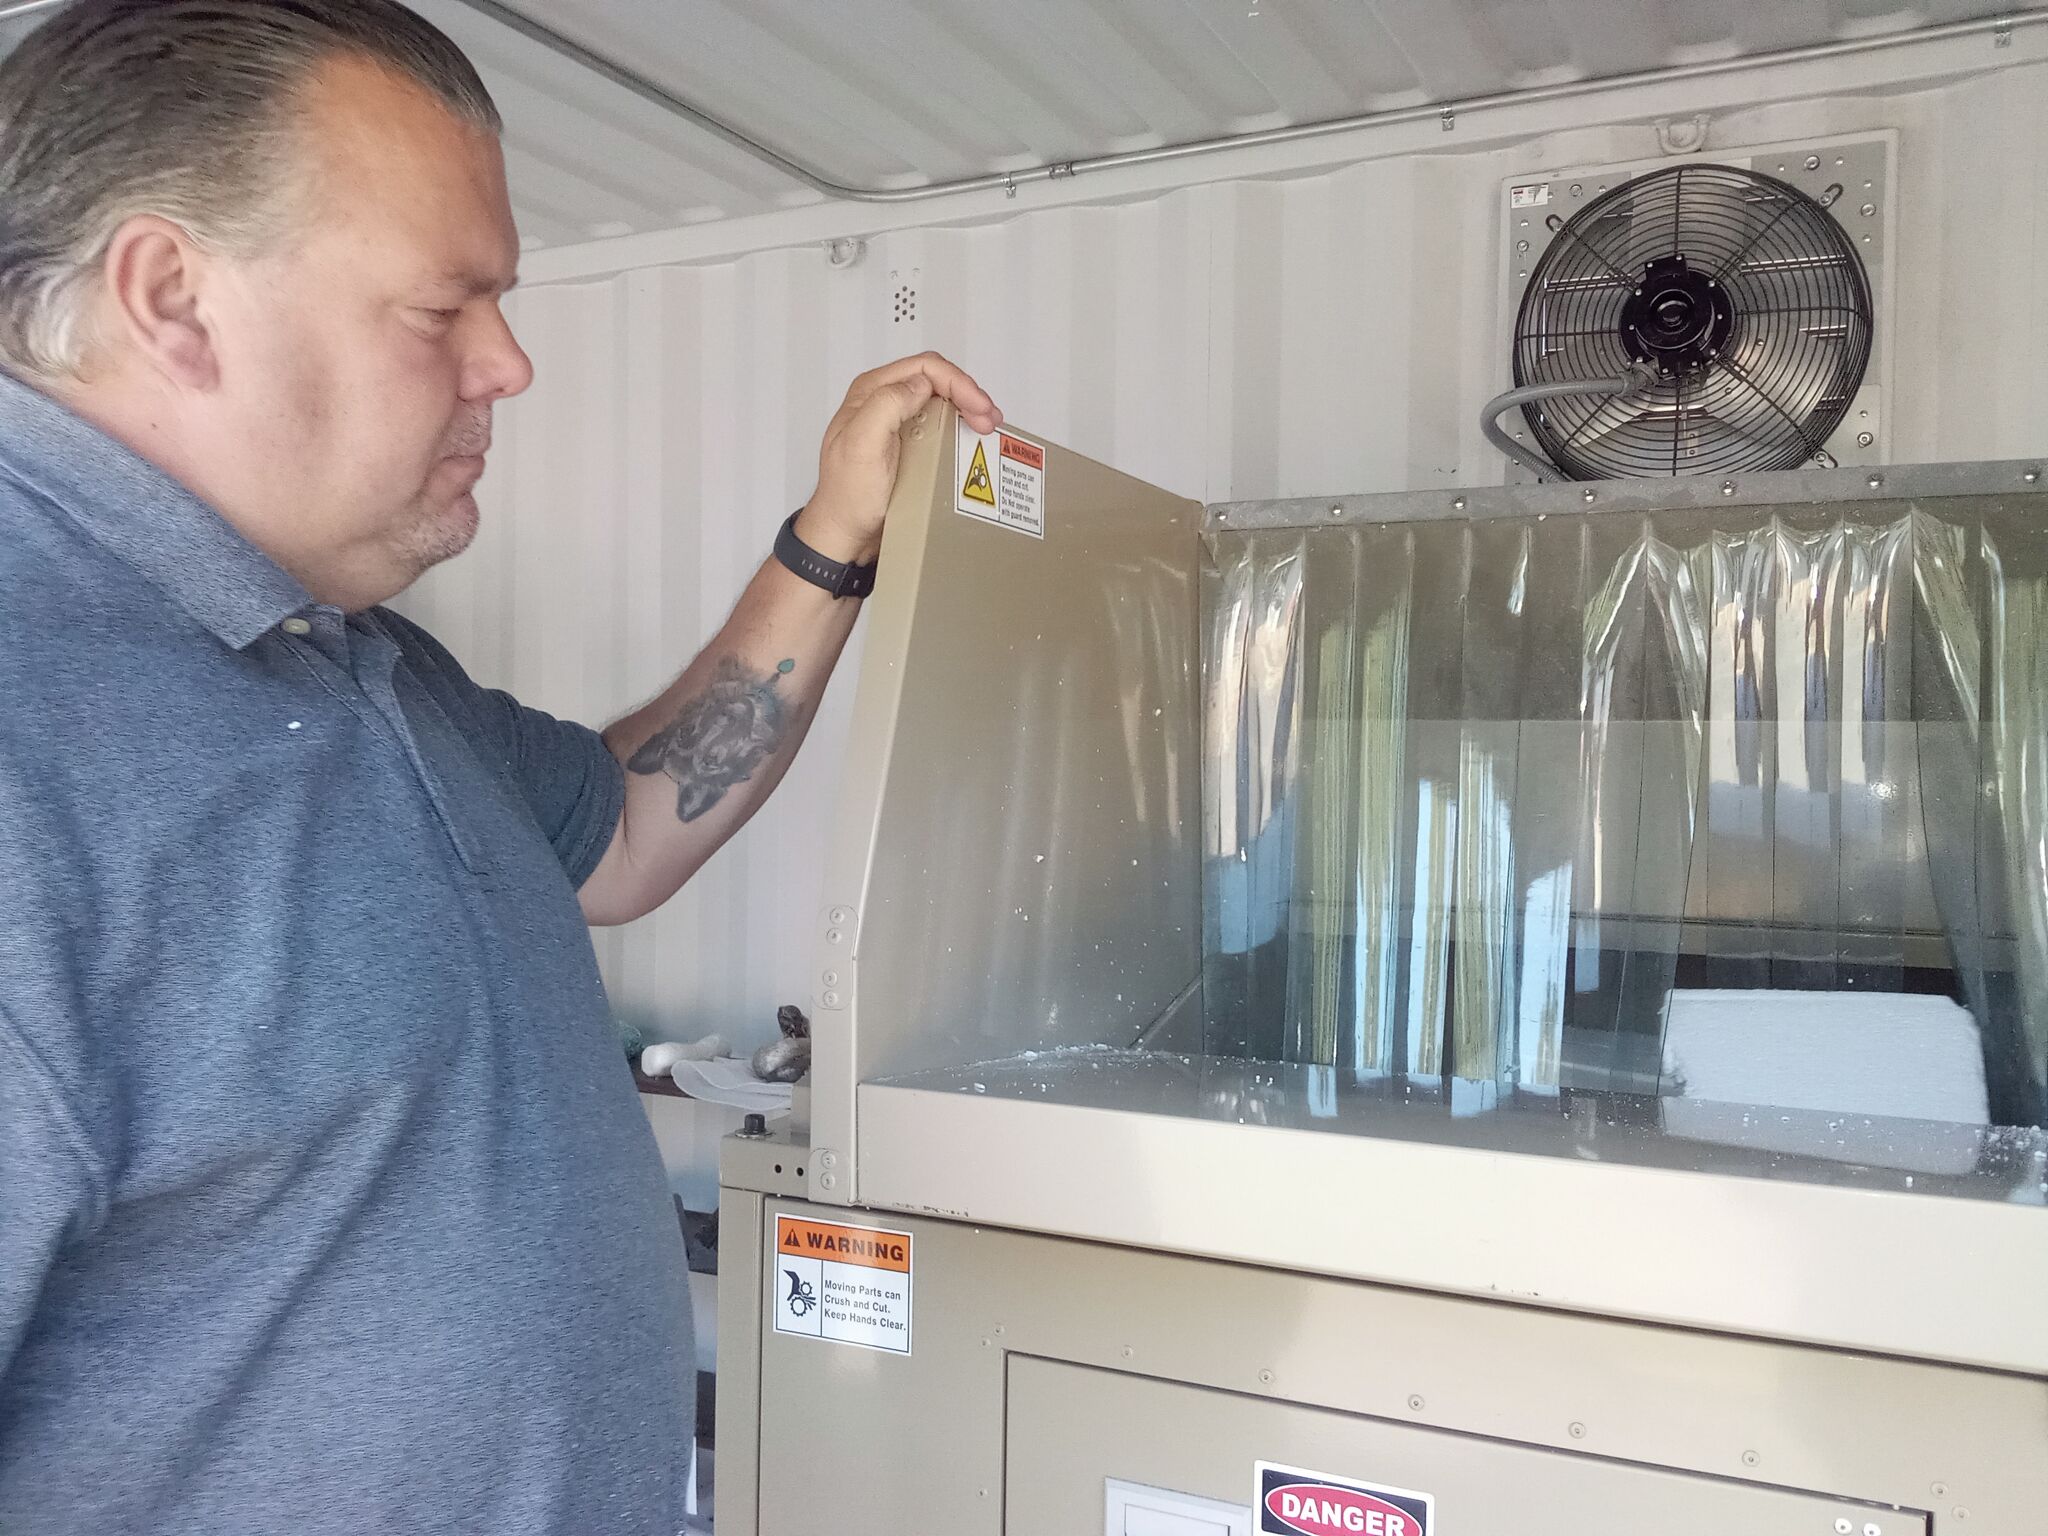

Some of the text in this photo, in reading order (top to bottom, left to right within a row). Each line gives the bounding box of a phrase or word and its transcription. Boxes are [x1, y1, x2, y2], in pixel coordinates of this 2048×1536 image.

[1011, 442, 1040, 464] WARNING
[1002, 464, 1016, 477] Moving
[1017, 470, 1027, 481] parts
[1002, 476, 1013, 486] crush
[1014, 479, 1022, 488] and
[1002, 486, 1013, 497] Keep
[1013, 489, 1025, 500] hands
[1002, 496, 1008, 505] Do
[1016, 502, 1030, 513] operate
[1002, 508, 1010, 517] with
[1011, 511, 1022, 521] guard
[806, 1231, 904, 1262] WARNING
[824, 1280, 901, 1300] Moving Parts can
[824, 1294, 891, 1313] Crush and Cut.
[824, 1308, 907, 1331] Keep Hands Clear.
[1281, 1492, 1406, 1536] DANGER
